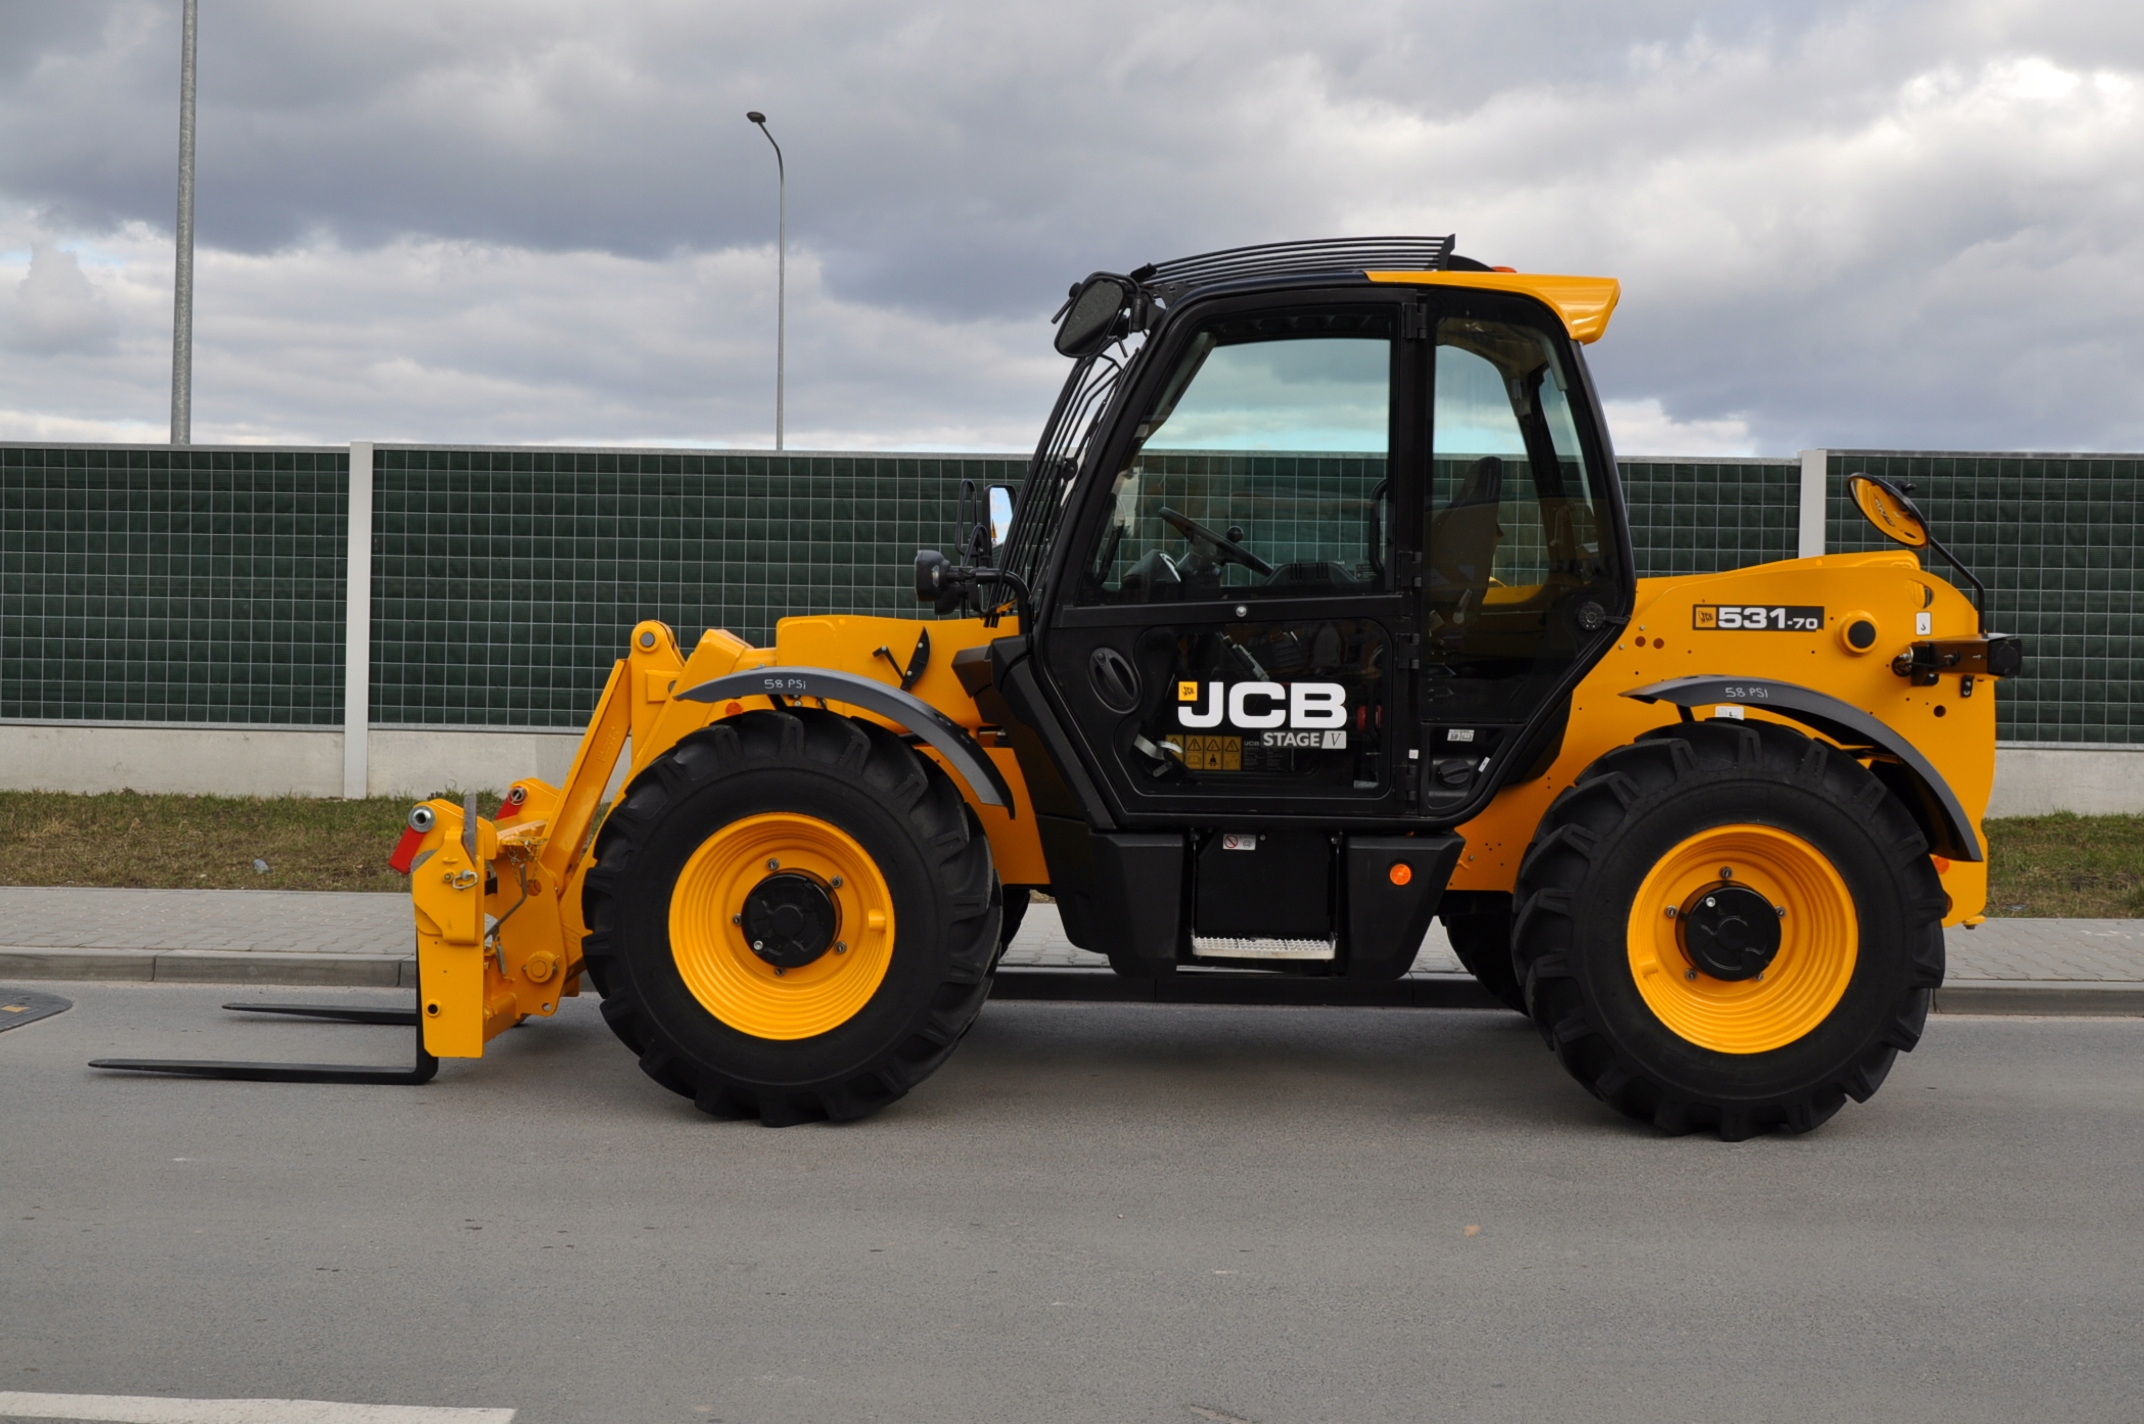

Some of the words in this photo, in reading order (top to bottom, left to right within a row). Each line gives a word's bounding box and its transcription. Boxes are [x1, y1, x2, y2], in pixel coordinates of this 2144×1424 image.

[764, 679, 783, 689] 58
[1725, 687, 1746, 698] 58
[1749, 687, 1769, 698] PSI
[1178, 681, 1348, 729] JCB
[1263, 732, 1320, 747] STAGE
[1330, 733, 1342, 747] V
